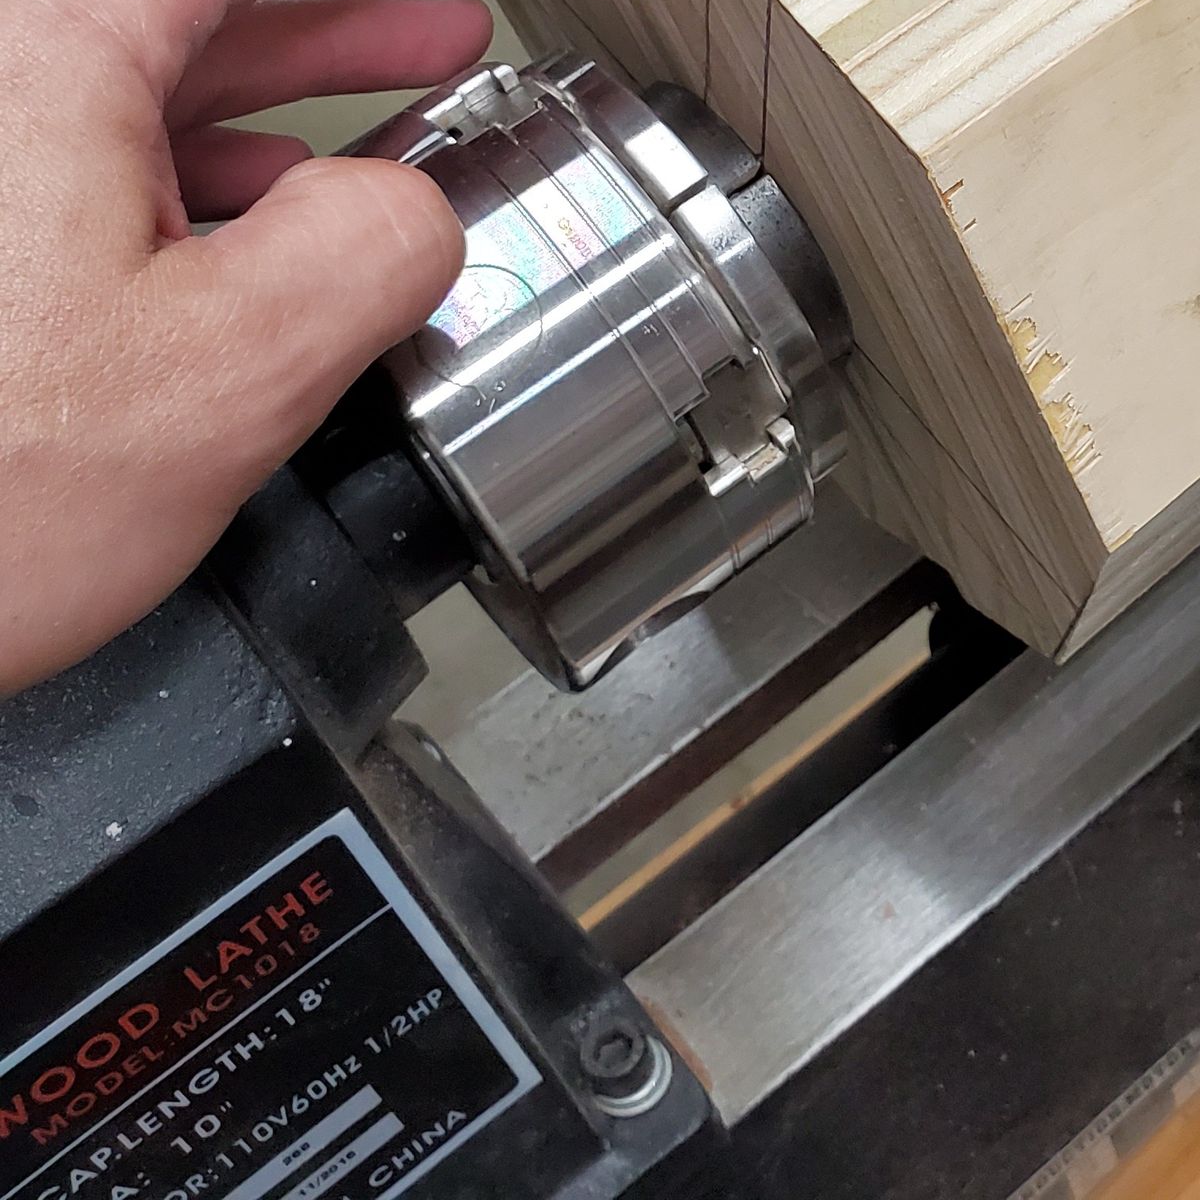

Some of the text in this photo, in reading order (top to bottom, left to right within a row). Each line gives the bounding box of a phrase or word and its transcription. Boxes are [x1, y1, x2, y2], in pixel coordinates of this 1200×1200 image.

[183, 870, 334, 991] LATHE
[364, 988, 443, 1056] 1/2HP
[369, 1109, 468, 1188] CHINA
